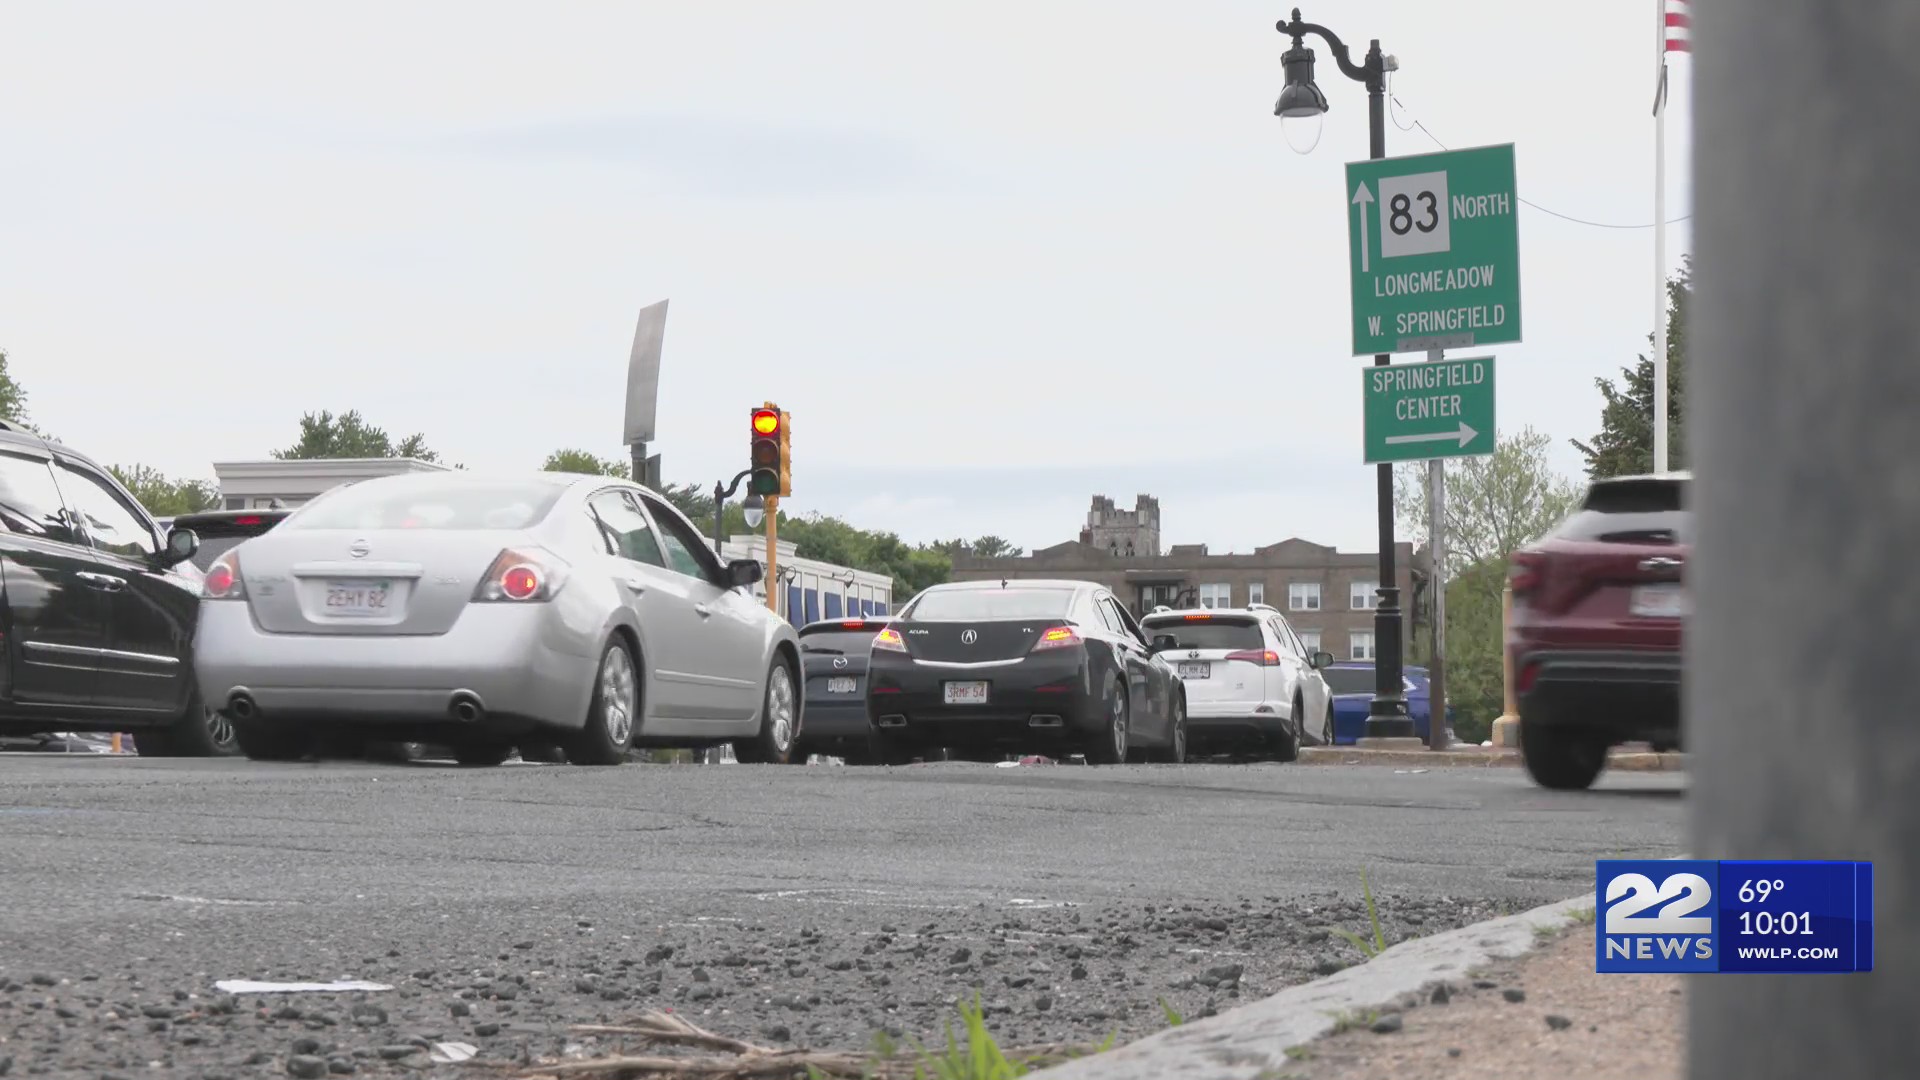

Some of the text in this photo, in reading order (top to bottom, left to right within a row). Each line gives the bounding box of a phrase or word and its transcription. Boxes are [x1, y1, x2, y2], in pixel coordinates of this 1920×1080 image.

[1389, 190, 1510, 236] 83 NORTH
[1375, 264, 1495, 297] LONGMEADOW
[1368, 304, 1505, 337] W. SPRINGFIELD
[1373, 362, 1484, 393] SPRINGFIELD
[1396, 394, 1461, 421] CENTER
